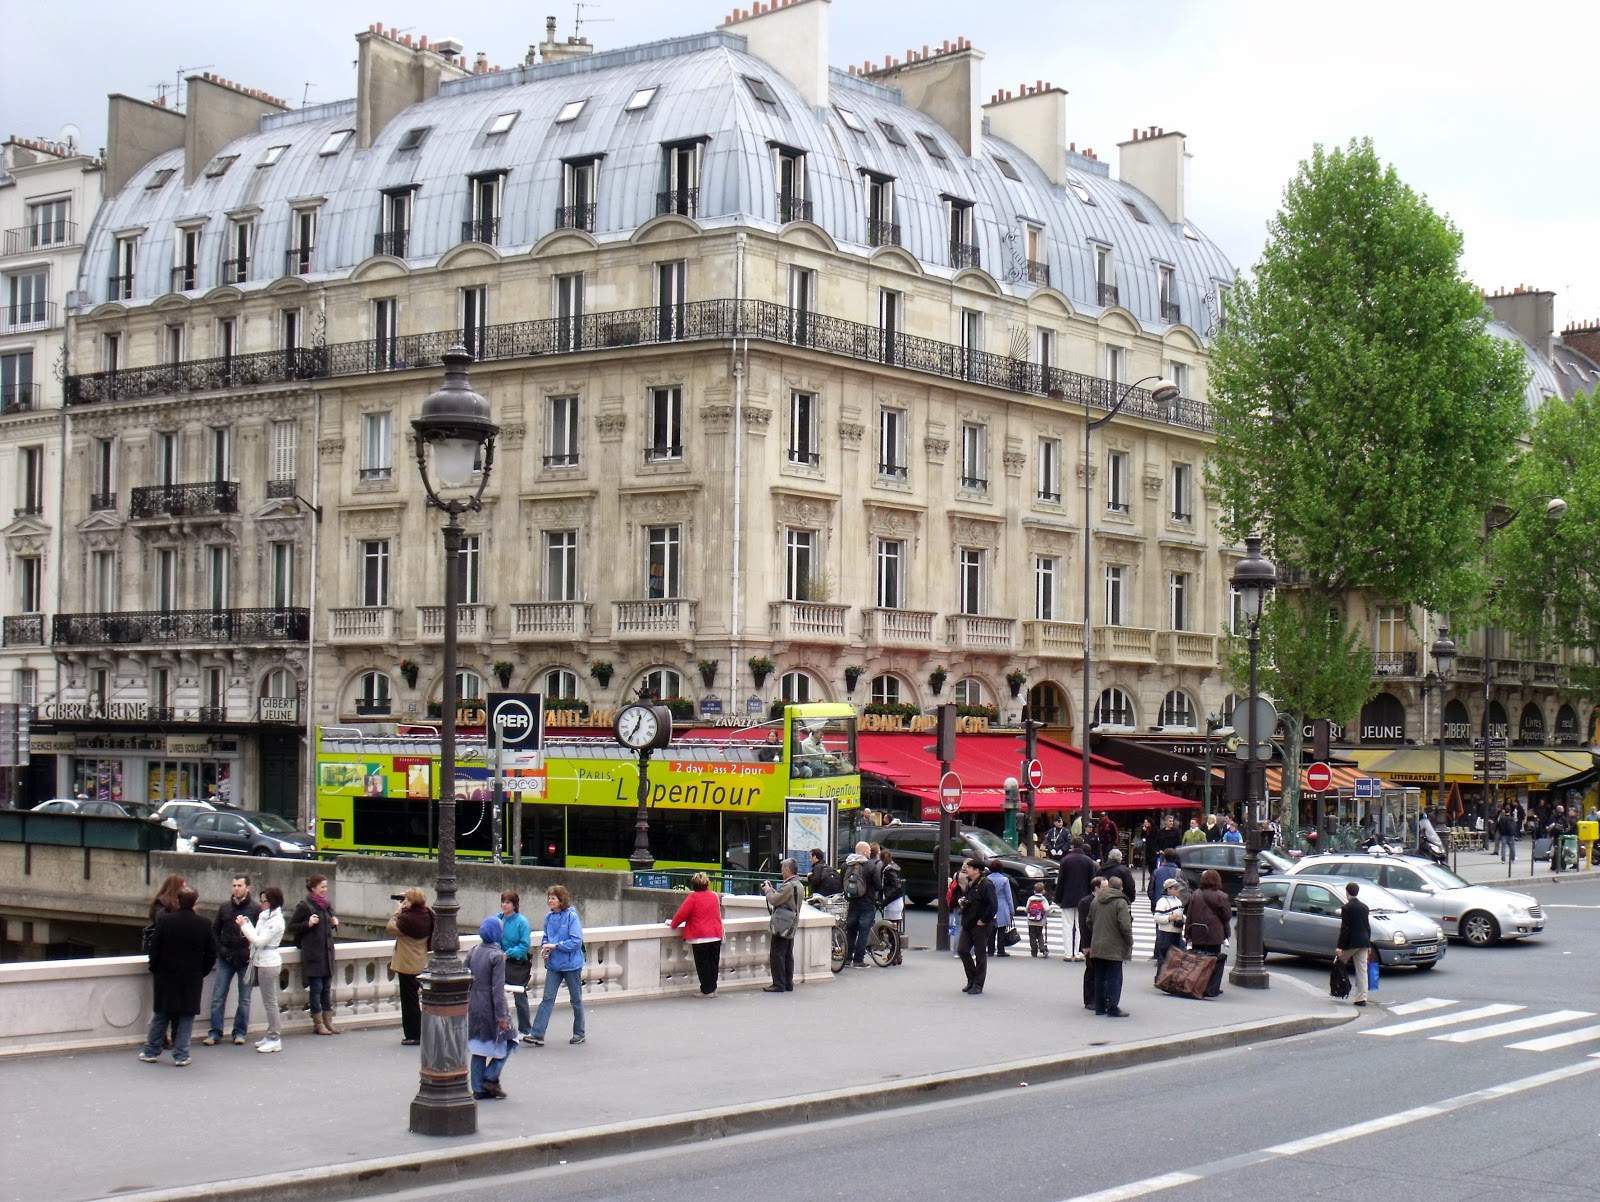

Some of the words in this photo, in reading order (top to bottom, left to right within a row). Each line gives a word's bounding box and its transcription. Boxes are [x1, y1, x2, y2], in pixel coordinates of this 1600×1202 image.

[262, 698, 295, 709] GIBERT
[45, 702, 87, 720] GIBERT
[102, 702, 148, 720] JEUNE
[264, 710, 292, 720] JEUNE
[497, 714, 529, 728] RER
[545, 709, 614, 727] AINT-MIC
[715, 718, 759, 727] LAVAZZA
[1302, 725, 1343, 738] GIRT
[1361, 725, 1403, 739] JEUNE
[1443, 723, 1471, 739] GIBERT
[1488, 723, 1508, 739] EUNE
[86, 738, 142, 749] GIBERT
[1173, 745, 1195, 754] Saint
[676, 763, 682, 773] 2
[686, 763, 704, 776] day
[707, 764, 727, 774] Pass
[731, 764, 737, 774] 2
[1154, 771, 1188, 782] café
